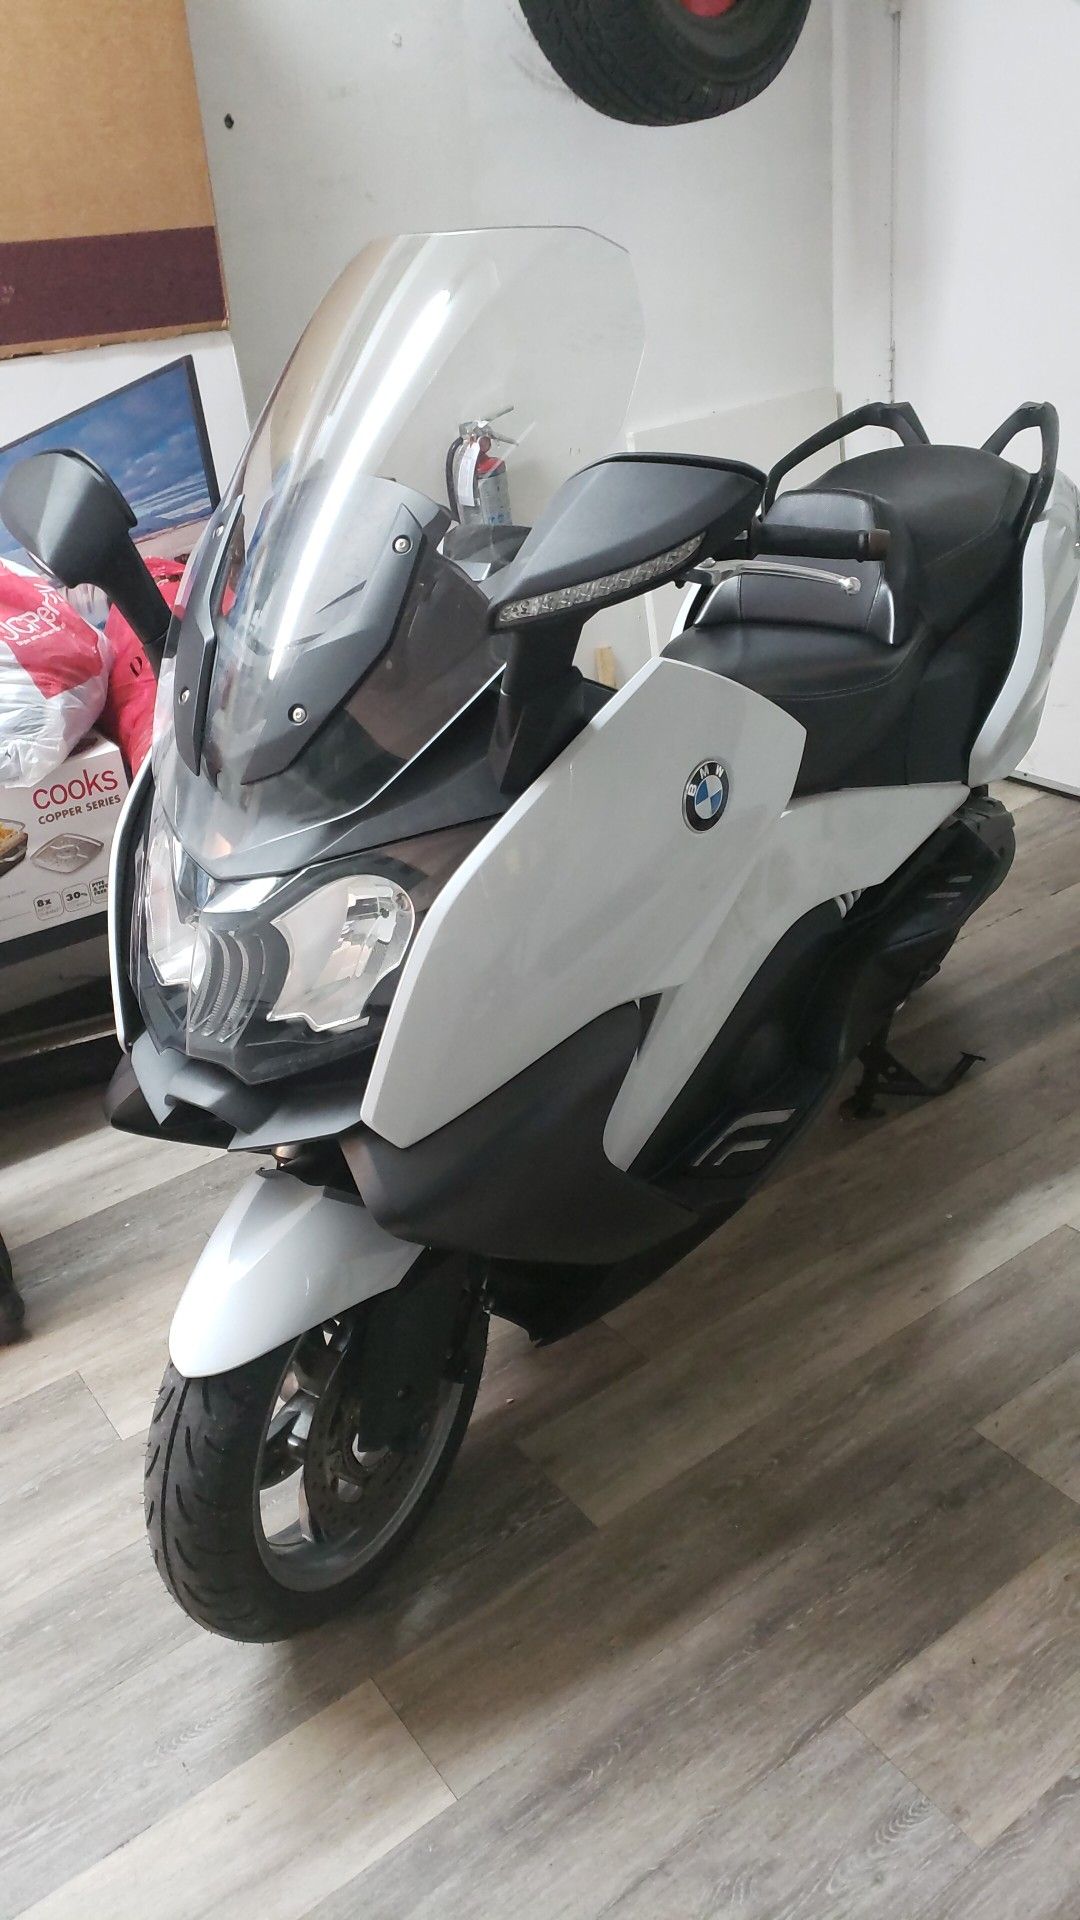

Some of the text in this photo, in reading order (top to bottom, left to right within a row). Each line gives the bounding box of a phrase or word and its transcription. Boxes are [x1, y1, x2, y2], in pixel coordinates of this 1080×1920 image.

[32, 769, 118, 810] cooks
[688, 764, 725, 797] BMW
[38, 794, 121, 825] COPPER SERIES
